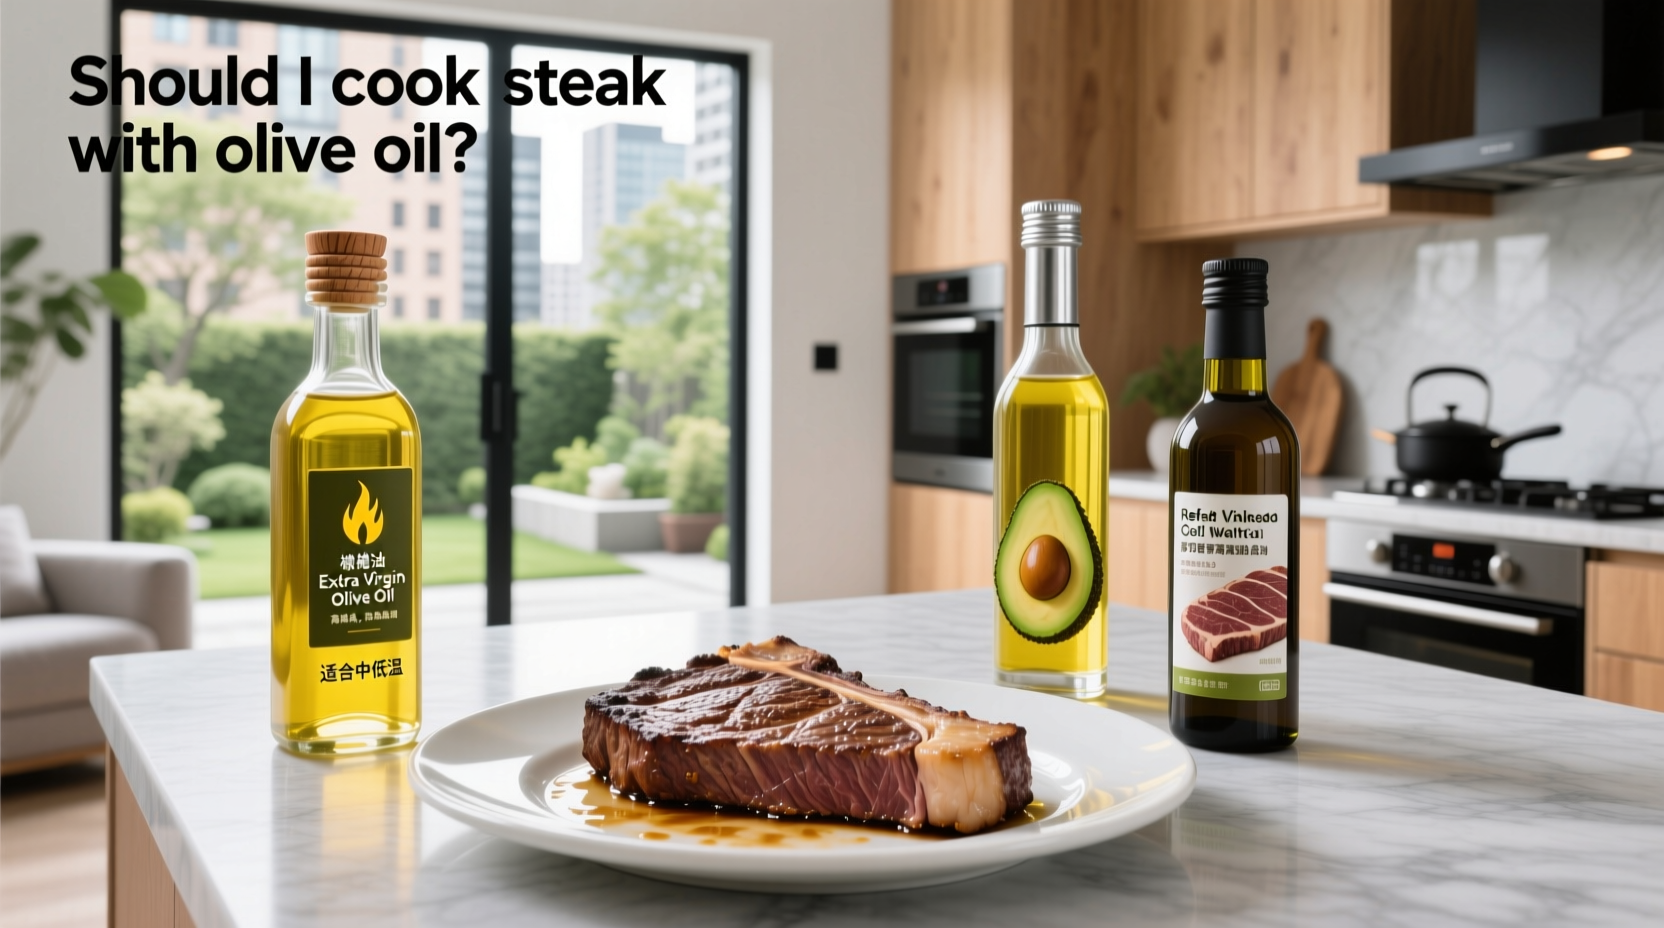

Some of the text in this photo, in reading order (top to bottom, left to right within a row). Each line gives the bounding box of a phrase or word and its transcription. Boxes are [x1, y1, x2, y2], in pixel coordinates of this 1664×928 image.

[319, 570, 406, 589] Extra Virgin
[331, 591, 371, 607] Olive
[320, 657, 403, 684] 适合中低温
